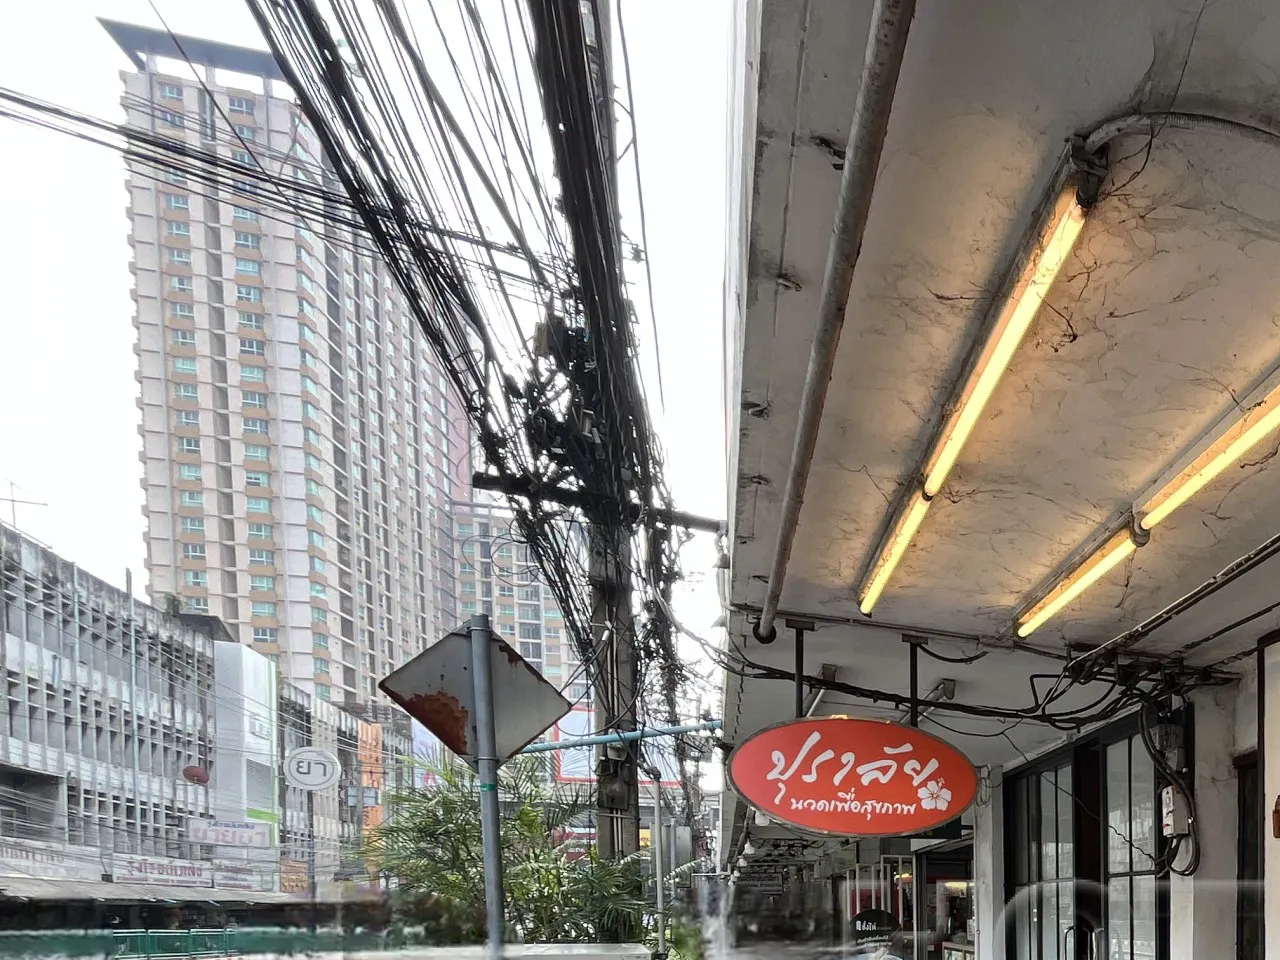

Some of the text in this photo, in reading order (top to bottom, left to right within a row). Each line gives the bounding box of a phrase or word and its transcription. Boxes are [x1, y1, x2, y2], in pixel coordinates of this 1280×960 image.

[790, 787, 916, 821] นวดเพื่อสุขภาพ
